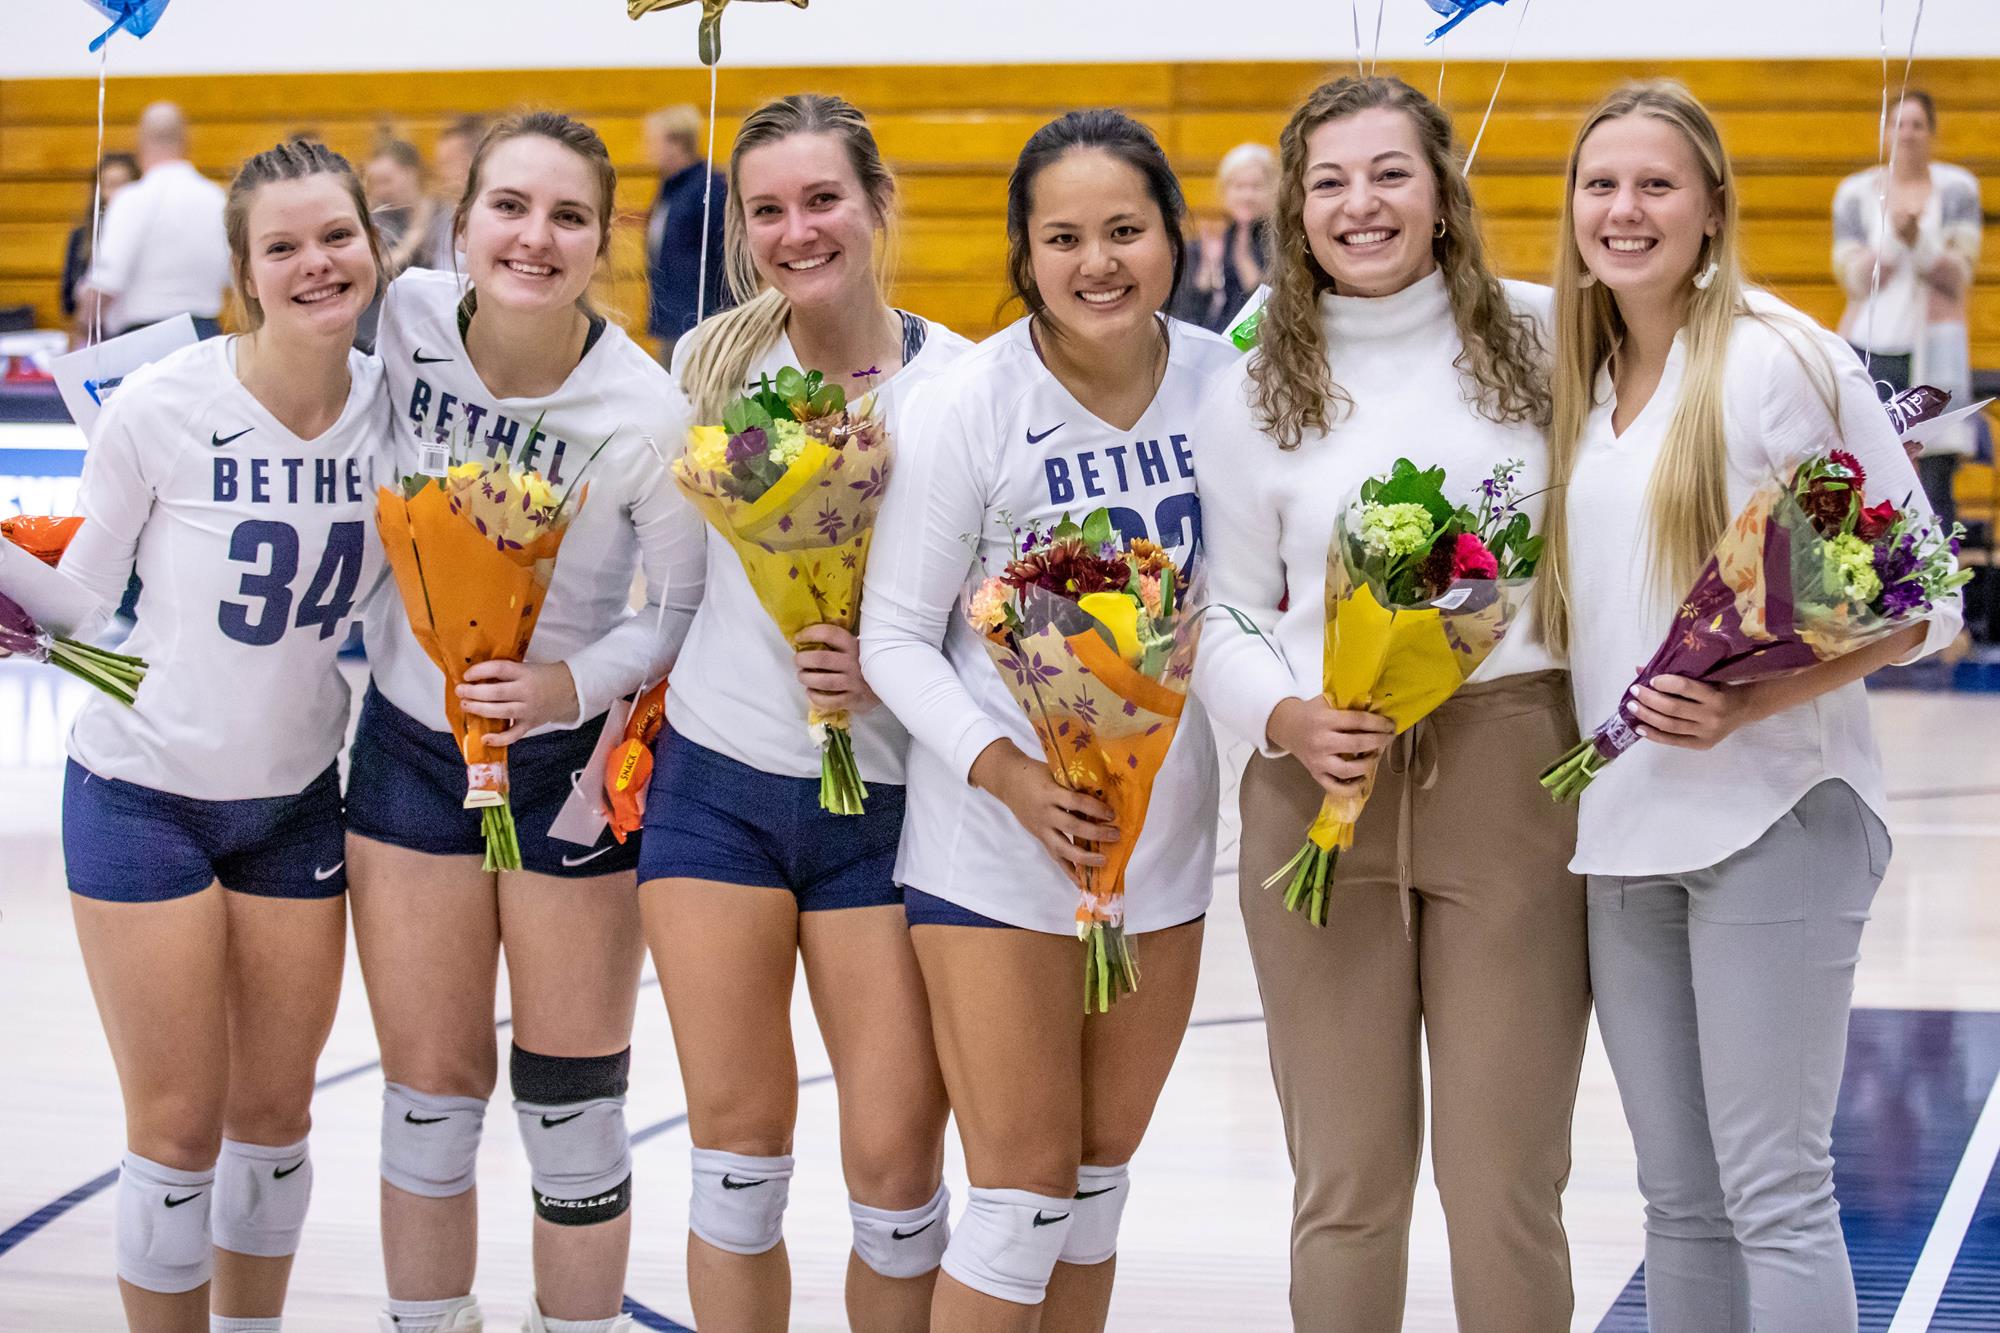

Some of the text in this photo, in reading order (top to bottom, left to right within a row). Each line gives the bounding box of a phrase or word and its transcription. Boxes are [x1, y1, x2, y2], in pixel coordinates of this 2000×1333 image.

[409, 377, 567, 487] BETHEL
[213, 457, 363, 503] BETHE
[1045, 434, 1194, 505] BETHE
[218, 519, 365, 647] 34
[620, 754, 637, 781] SNACK
[547, 1194, 619, 1208] MUELLER
